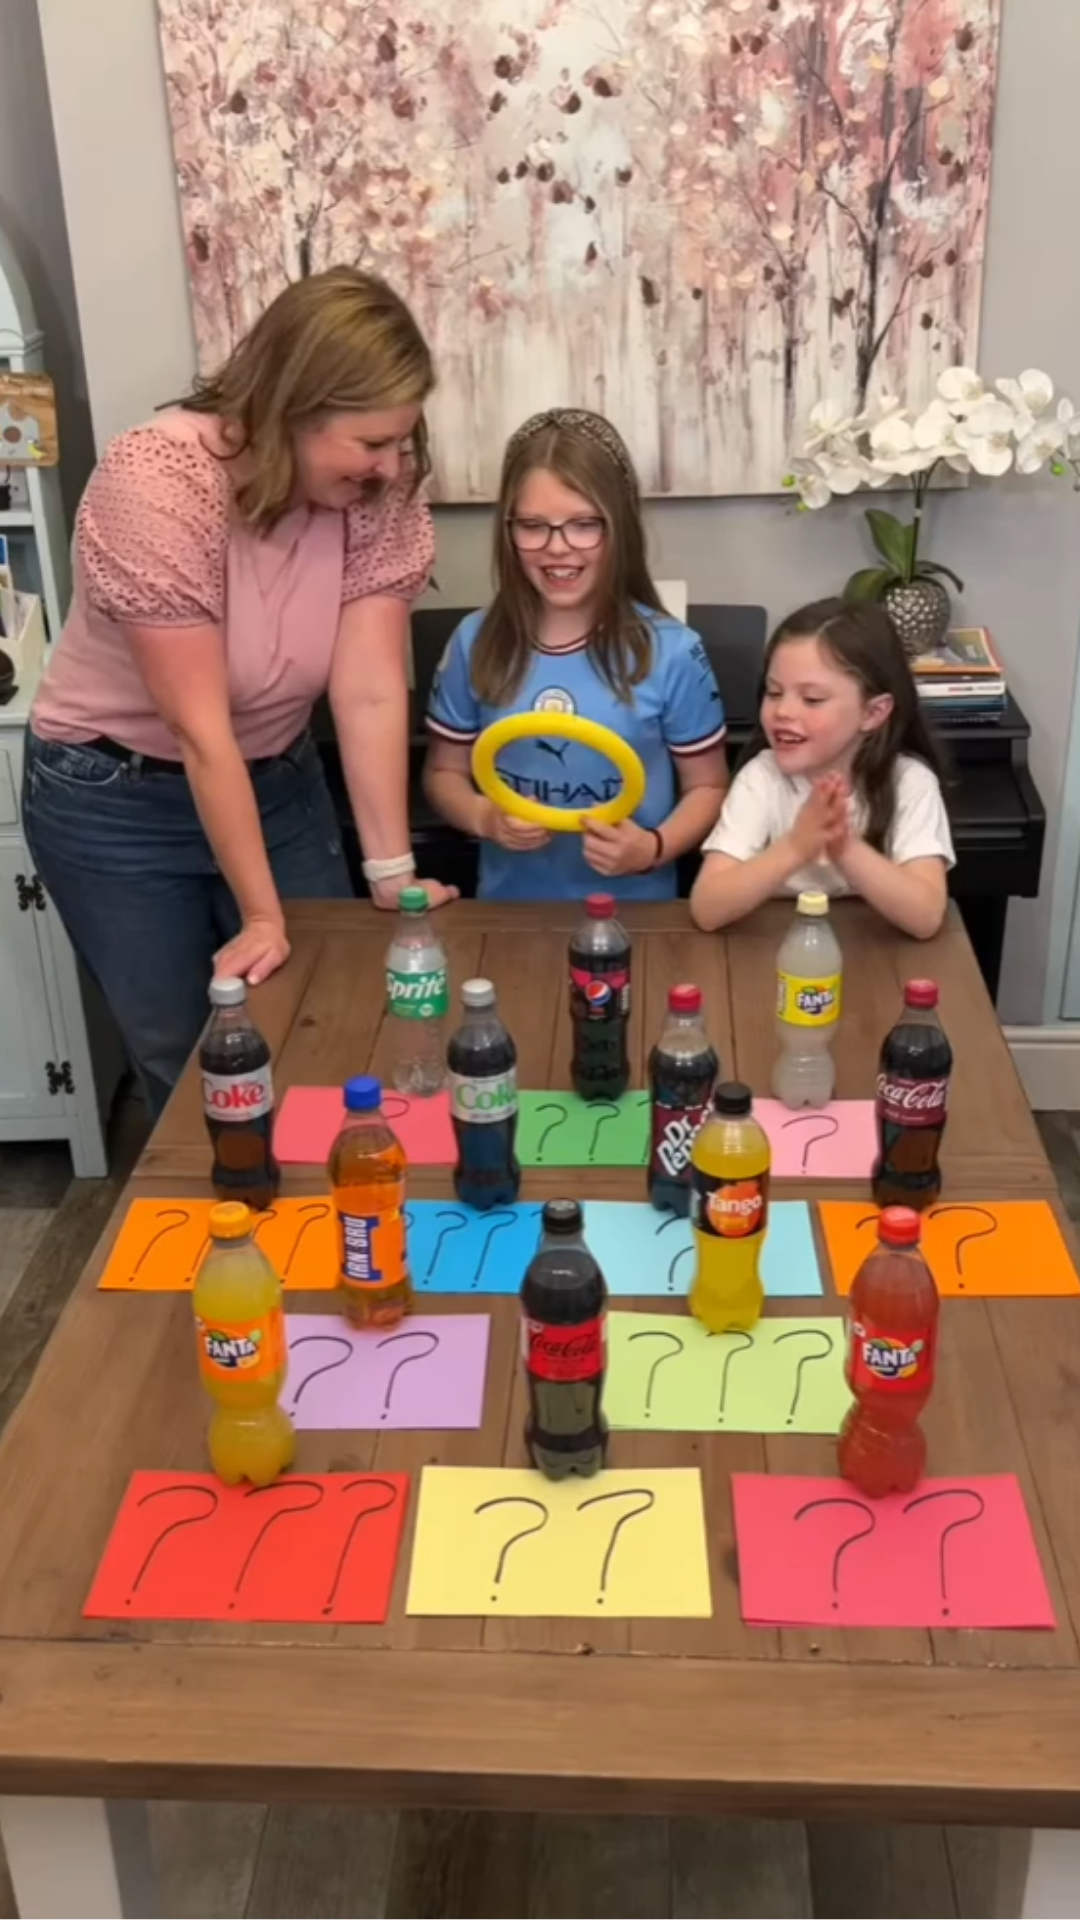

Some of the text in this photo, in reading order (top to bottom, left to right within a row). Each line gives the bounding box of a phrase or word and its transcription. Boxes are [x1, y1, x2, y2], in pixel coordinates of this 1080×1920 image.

[386, 969, 445, 1000] Sprite
[664, 1114, 692, 1148] Dr
[706, 1191, 762, 1216] Tango
[205, 1335, 257, 1359] FANTA
[862, 1341, 916, 1367] FANTA
